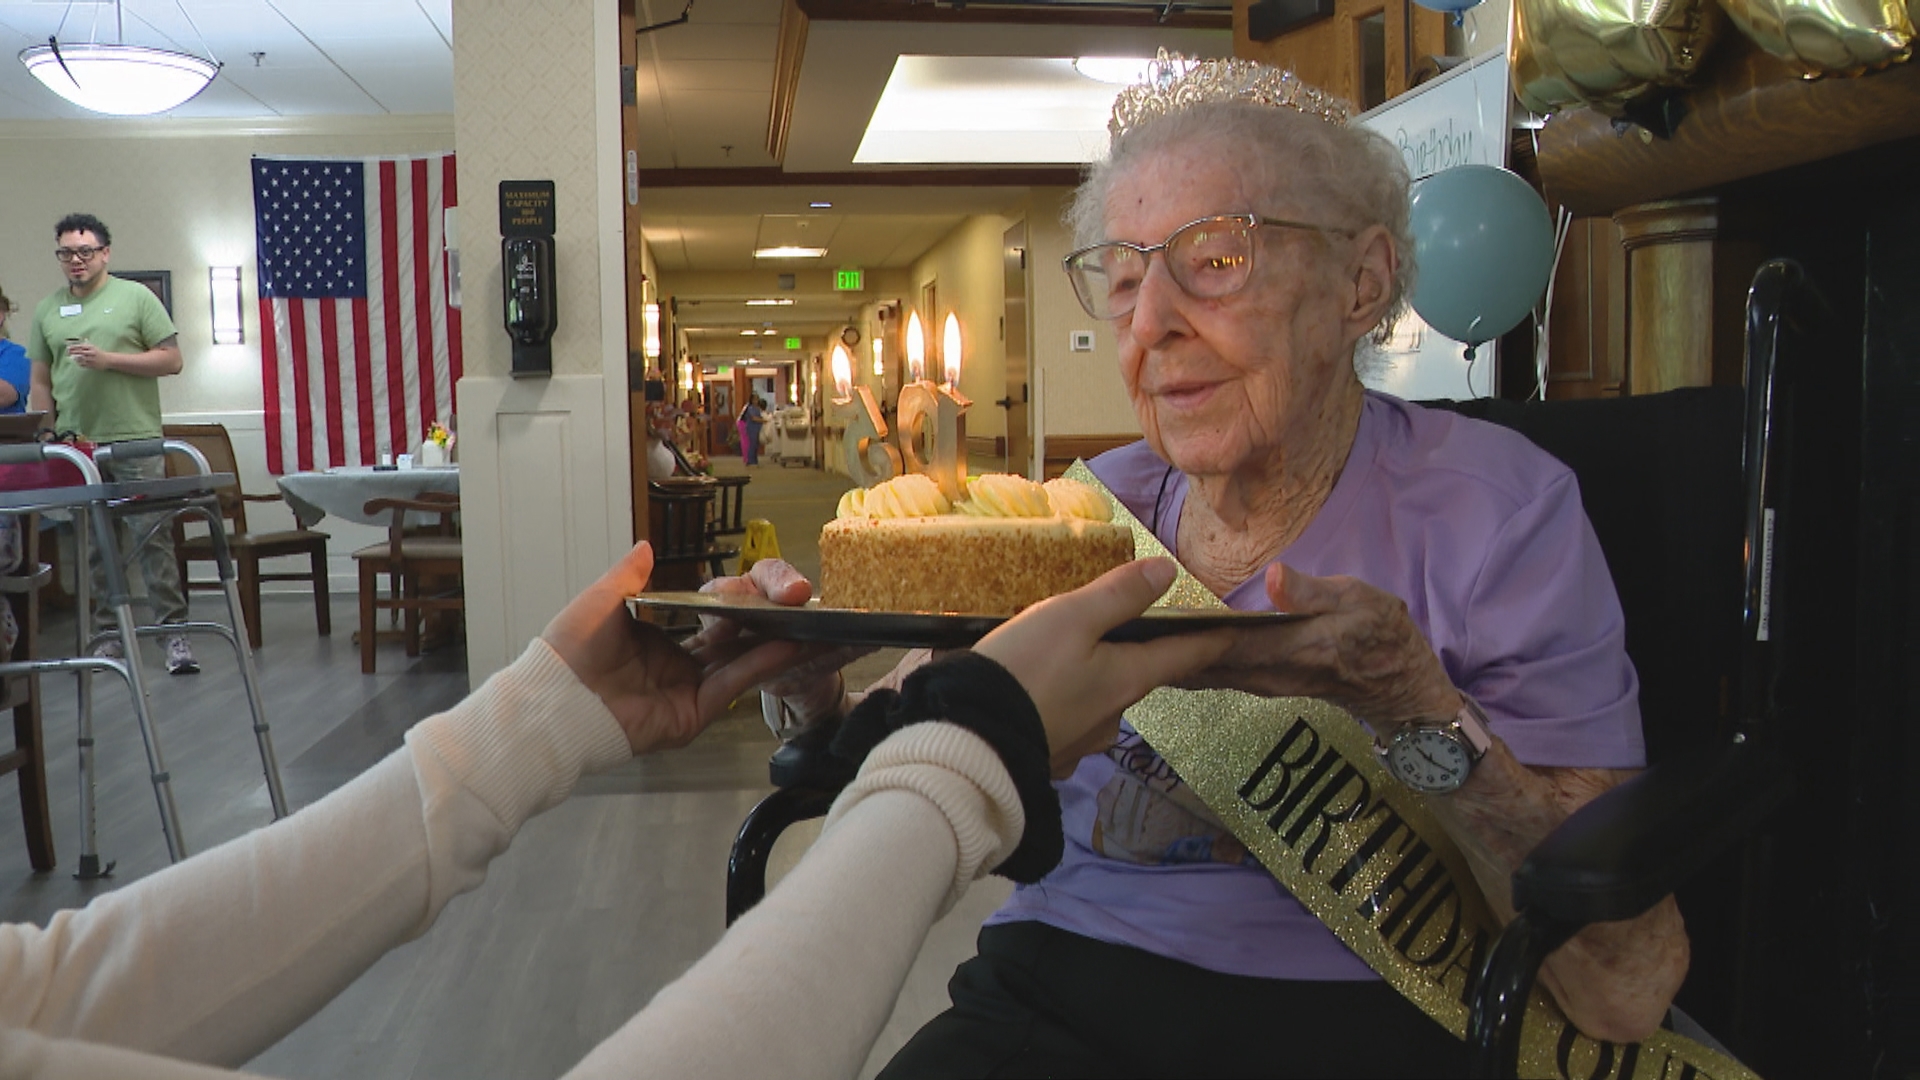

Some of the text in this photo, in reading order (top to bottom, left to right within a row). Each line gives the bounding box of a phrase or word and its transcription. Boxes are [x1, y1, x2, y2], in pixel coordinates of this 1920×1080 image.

[505, 191, 550, 199] MAXIMUM
[512, 217, 543, 225] PEOPLE
[838, 271, 860, 289] EXIT
[1237, 716, 1490, 1006] BIRTHDA
